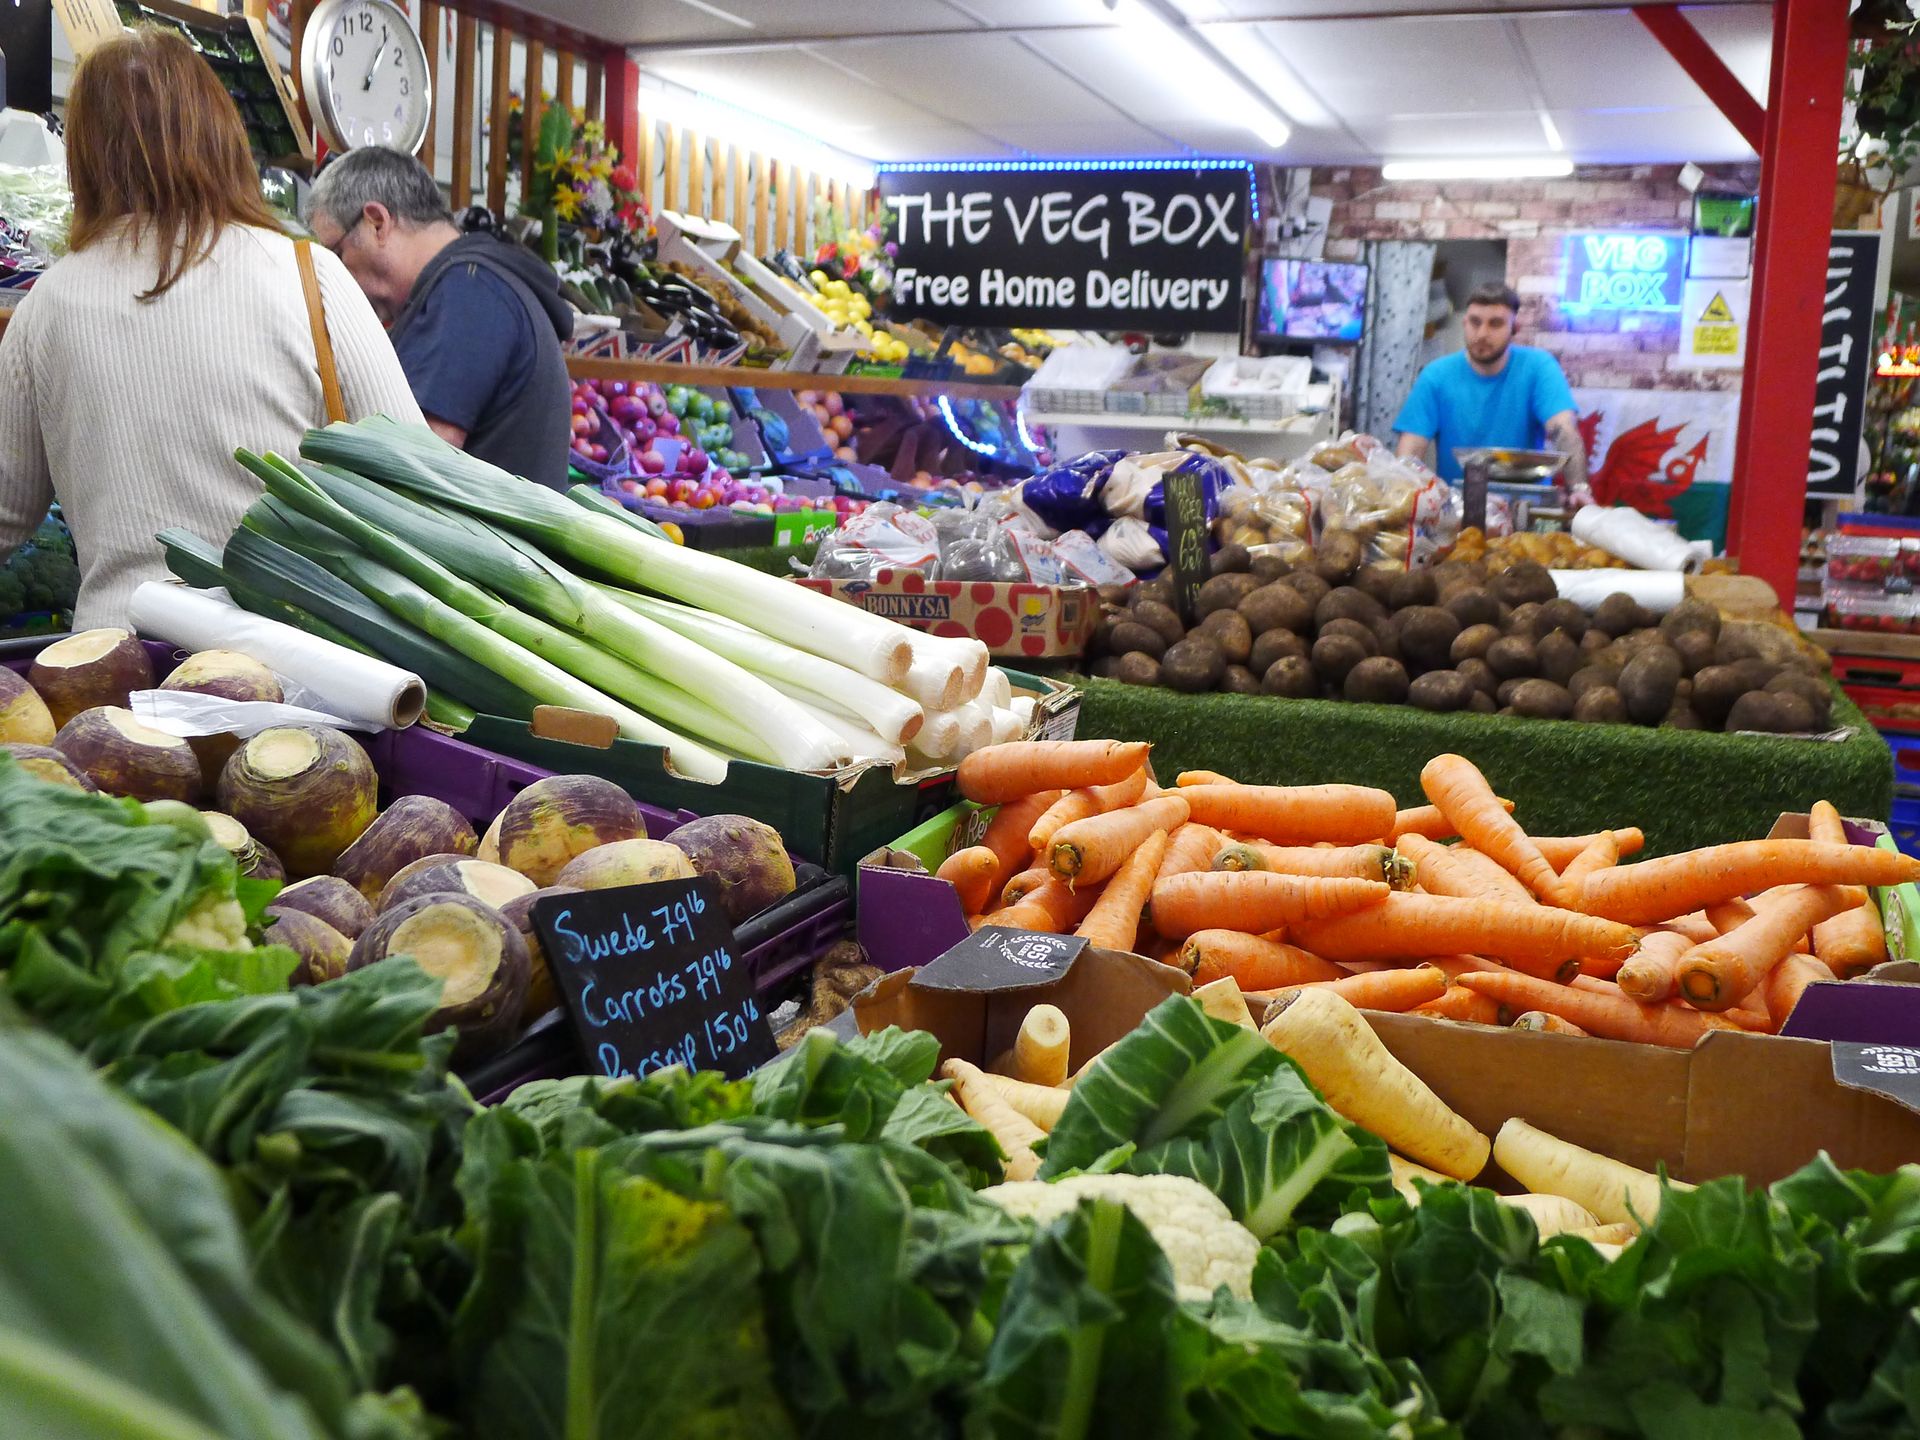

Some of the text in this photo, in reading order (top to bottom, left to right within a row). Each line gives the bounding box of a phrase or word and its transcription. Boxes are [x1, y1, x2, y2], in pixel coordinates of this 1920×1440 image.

[342, 15, 354, 35] 11
[358, 12, 373, 32] 12
[332, 37, 343, 57] 0
[394, 47, 402, 66] 2
[400, 77, 409, 95] 3
[394, 103, 404, 124] 4
[364, 127, 375, 147] 6
[382, 121, 393, 142] 5
[886, 190, 1240, 259] THE VEG BOX
[1583, 234, 1668, 271] VEG
[894, 268, 1229, 310] Free Home Delivery
[1580, 270, 1668, 305] BOX
[866, 594, 949, 619] BONNYSA
[554, 909, 654, 963] Swede
[1027, 943, 1052, 961] 65
[581, 971, 686, 1028] Carrots
[1876, 1053, 1905, 1067] 65
